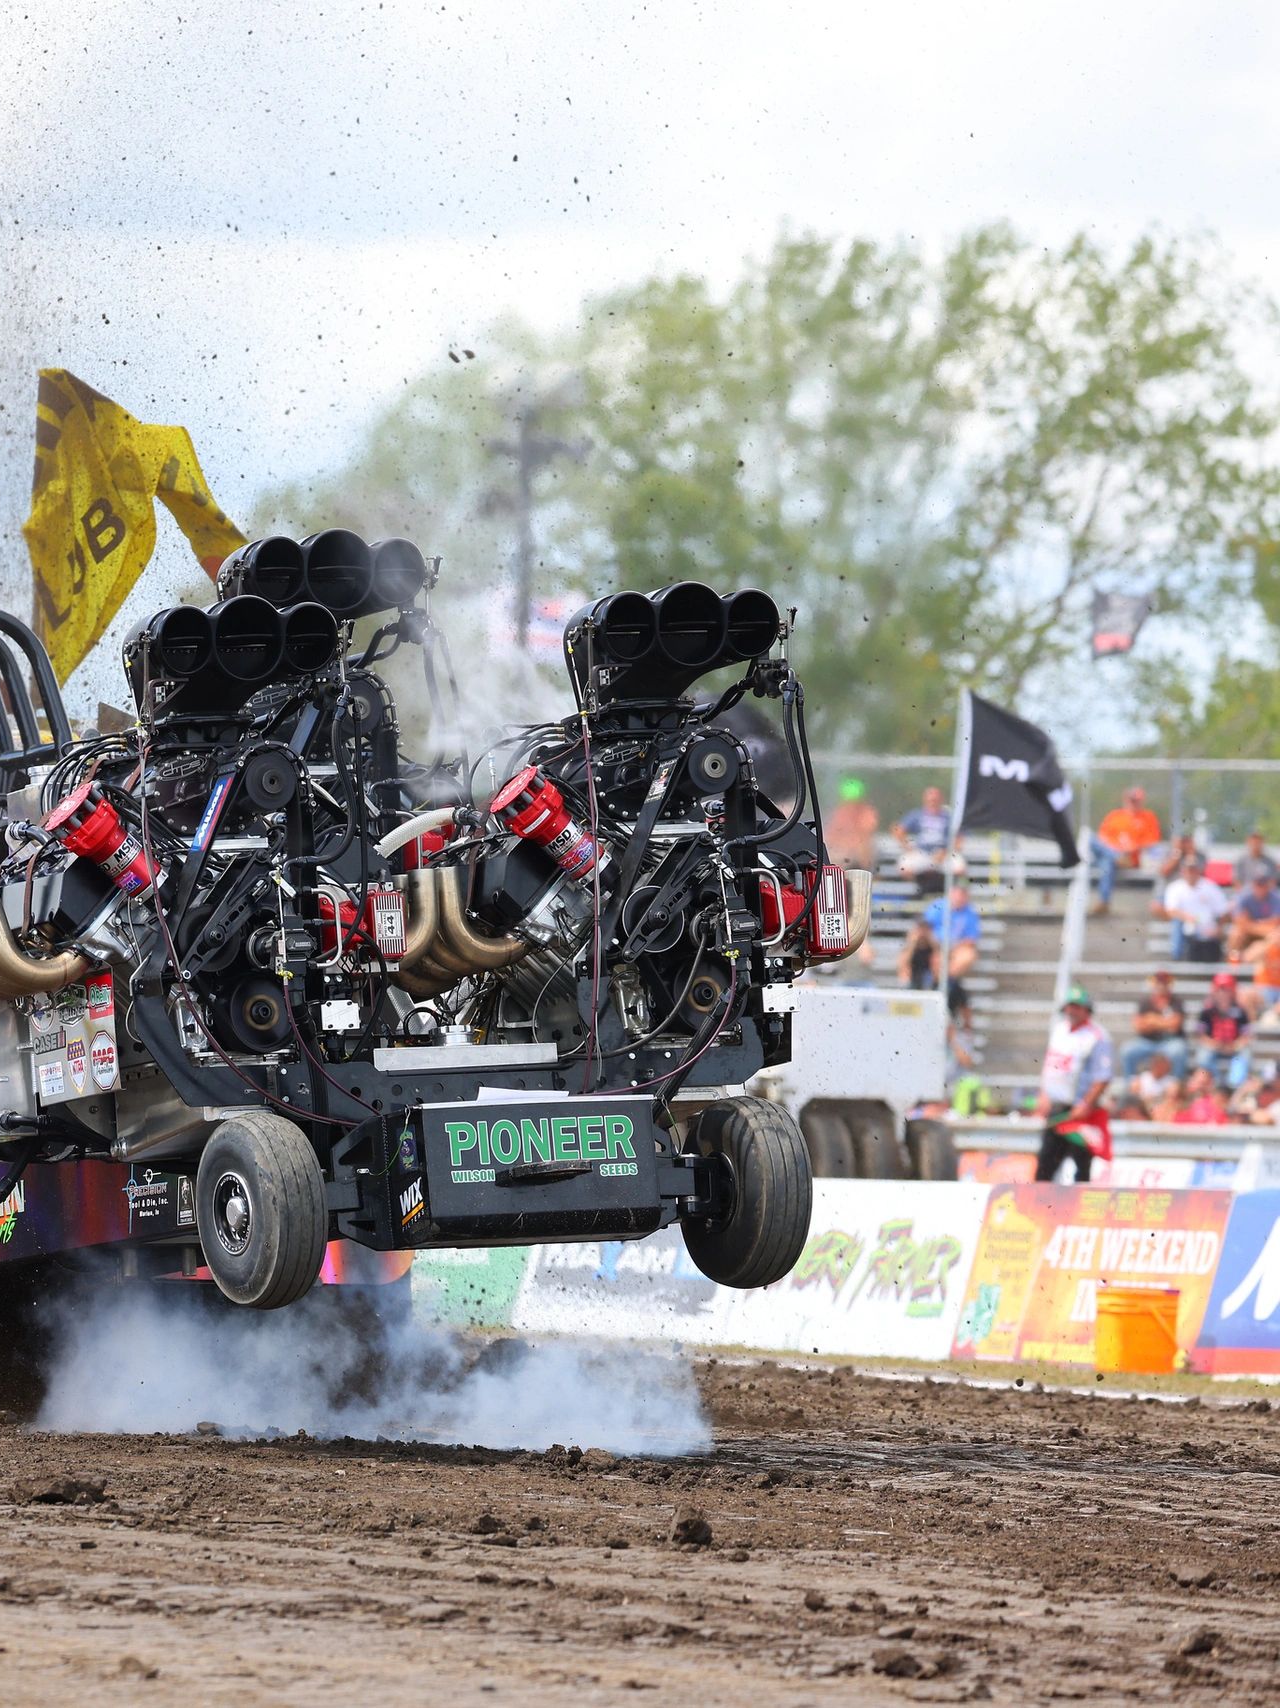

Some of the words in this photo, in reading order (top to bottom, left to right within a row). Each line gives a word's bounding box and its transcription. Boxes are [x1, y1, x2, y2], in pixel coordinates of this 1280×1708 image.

[113, 838, 134, 863] MSD
[548, 829, 572, 854] MSD
[387, 915, 395, 934] 44
[33, 1033, 57, 1055] CASE
[445, 1114, 636, 1166] PIONEER
[451, 1169, 495, 1183] WILSON
[600, 1162, 638, 1177] SEEDS
[129, 1182, 168, 1197] PRECISION
[399, 1177, 423, 1216] WIX
[402, 1209, 425, 1232] FILTERS
[1043, 1225, 1099, 1270] 4TH
[1099, 1227, 1219, 1275] WEEKEND
